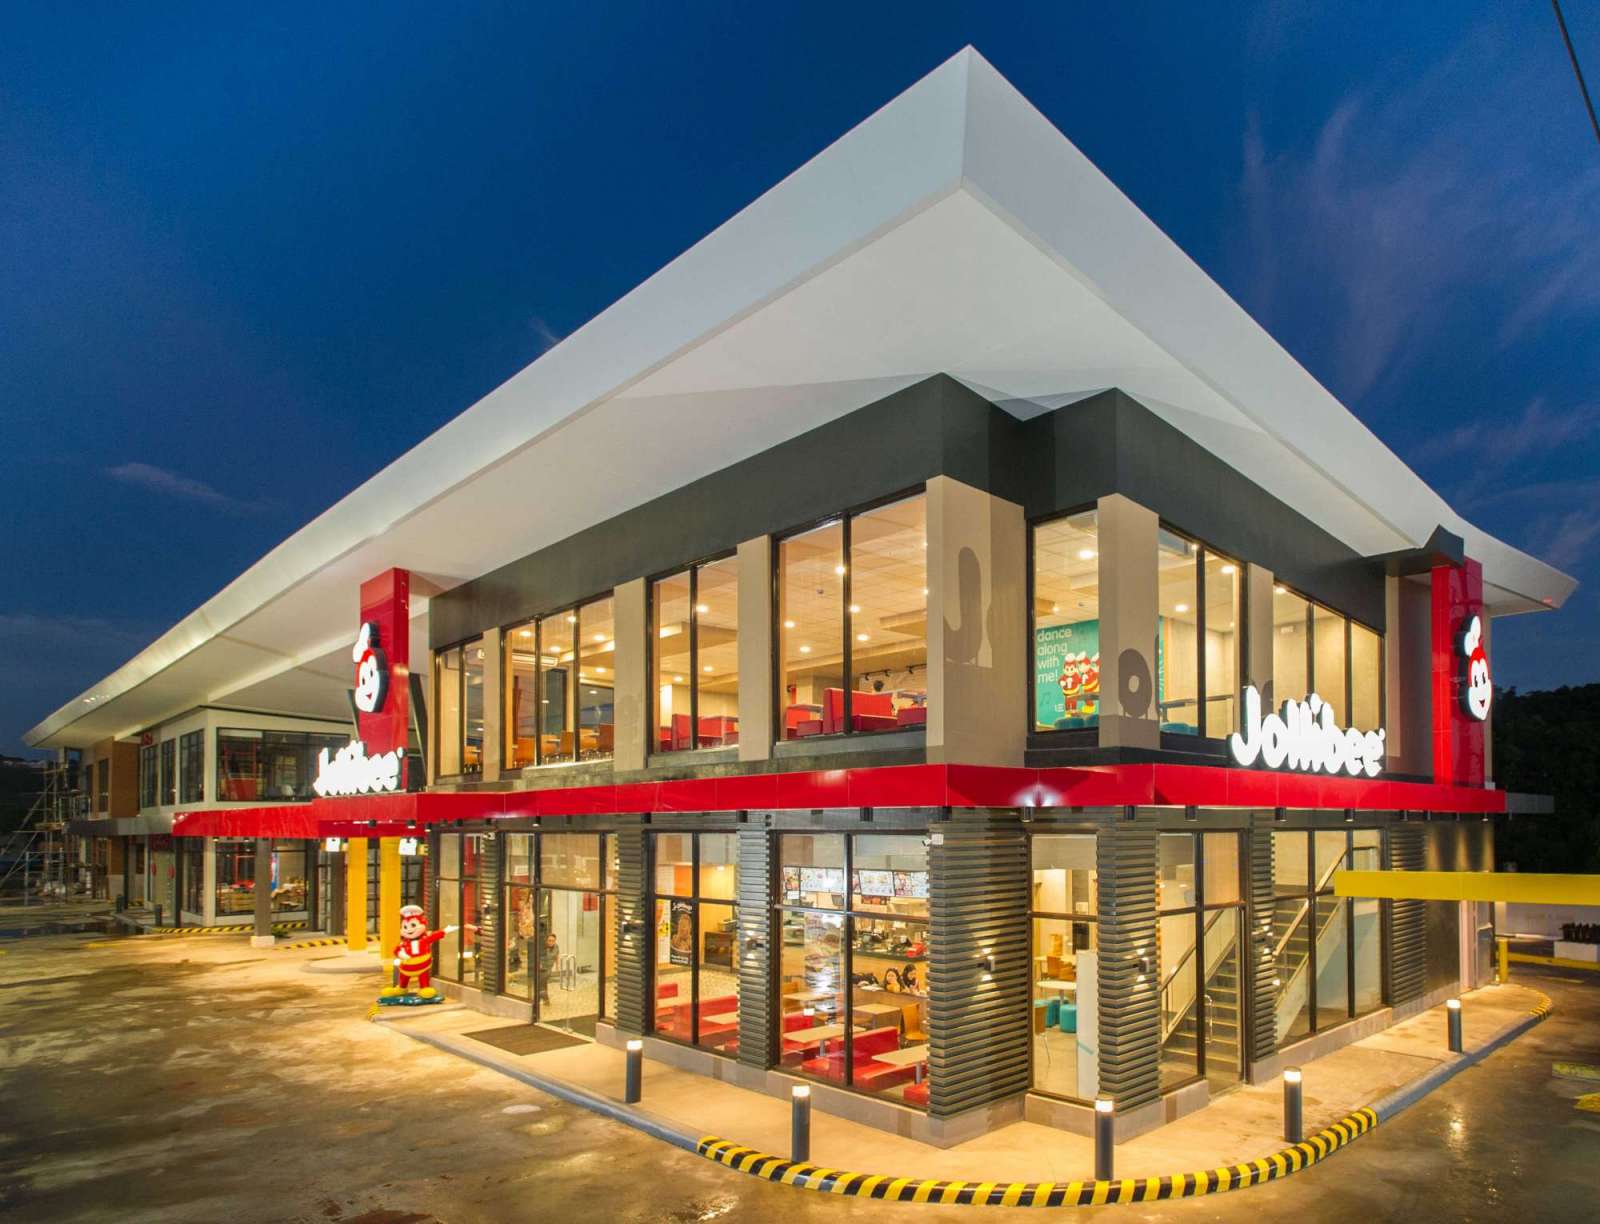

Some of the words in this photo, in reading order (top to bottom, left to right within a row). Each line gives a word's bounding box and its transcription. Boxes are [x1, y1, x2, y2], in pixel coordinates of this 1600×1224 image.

[1037, 628, 1072, 642] dance
[1037, 641, 1068, 656] along
[1038, 655, 1060, 669] with
[1038, 669, 1058, 684] me!
[1231, 685, 1384, 777] Jollibee
